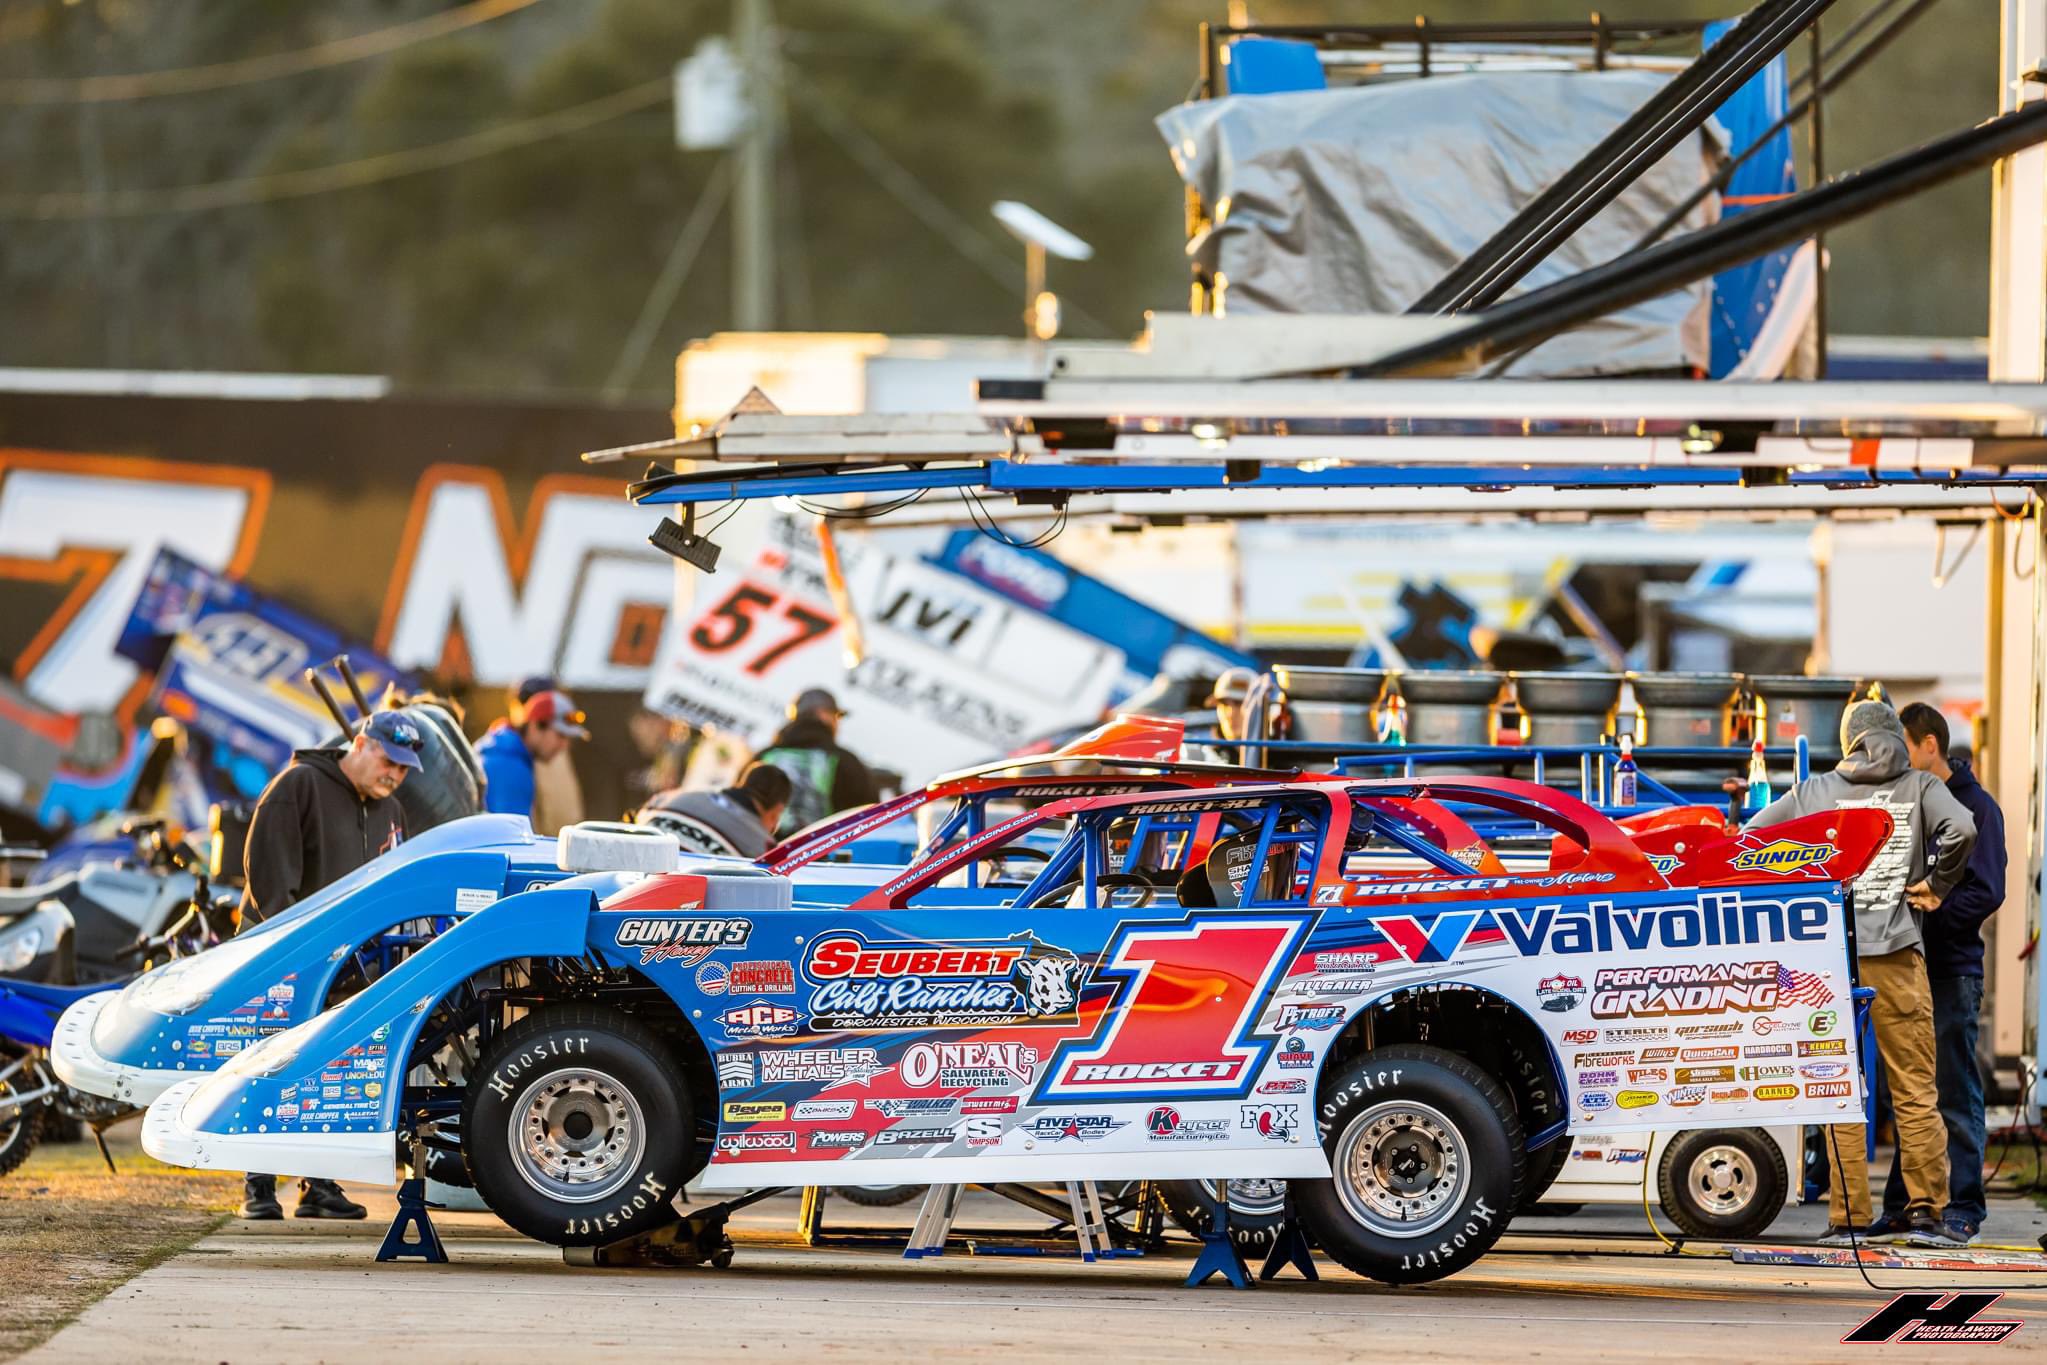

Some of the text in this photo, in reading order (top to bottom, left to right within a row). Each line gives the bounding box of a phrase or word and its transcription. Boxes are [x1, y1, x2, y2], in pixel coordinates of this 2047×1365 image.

[689, 580, 839, 678] 57
[1015, 786, 1098, 797] ROCKET
[1128, 801, 1220, 814] ROCKET
[884, 812, 1038, 896] WWW.ROCKET1RACING.COM
[1739, 847, 1829, 866] SUNOCO
[1356, 877, 1519, 896] ROCKET
[1542, 872, 1615, 884] Motors
[1316, 886, 1343, 903] 71
[618, 919, 750, 943] GUNTER'S
[1502, 893, 1829, 957] Valvoline
[812, 939, 1024, 976] SEUBERT
[1316, 953, 1377, 963] SHARP
[731, 969, 793, 984] CONCRETE
[1595, 962, 1778, 986] PERFORMANCE
[1292, 980, 1371, 991] ALLGAIER
[813, 977, 1013, 1015] Calf Ranches
[1593, 984, 1777, 1015] GRADING
[1036, 914, 1312, 1101] 1
[728, 1006, 794, 1025] ACE
[833, 1016, 1016, 1027] DORCHESTER, WISCONSIN
[1275, 1005, 1344, 1031] PETROFF
[762, 1024, 795, 1032] Works
[1605, 1027, 1668, 1036] STEALTH
[1563, 1030, 1598, 1042] MSD
[217, 1042, 240, 1050] BRS
[1744, 1044, 1787, 1054] HARDROCK
[1810, 1040, 1843, 1051] KENNY'S
[718, 1053, 752, 1063] BUBBA
[761, 1051, 875, 1066] WHEELER
[488, 1036, 591, 1101] Hoosier
[764, 1064, 845, 1080] METALS
[942, 1069, 1007, 1078] SALVAGE &
[1071, 1061, 1242, 1082] ROCKET
[1627, 1068, 1668, 1083] WILES
[1745, 1065, 1791, 1080] HOWE
[720, 1078, 752, 1088] ARMY
[942, 1078, 1008, 1086] RECYCLING
[1808, 1083, 1849, 1096] BRINN
[1759, 1087, 1794, 1096] BARNES
[728, 1104, 783, 1115] Beyea
[907, 1099, 957, 1108] WALKER
[1036, 1116, 1112, 1129] FIVE STAR
[1149, 1109, 1230, 1132] Keyser
[1241, 1104, 1298, 1130] FOX
[720, 1132, 794, 1149] wilwood
[811, 1131, 865, 1148] POWERS
[876, 1128, 957, 1144] BAZELL
[565, 1171, 667, 1236] Hoosier
[1401, 1196, 1498, 1271] Hoosier
